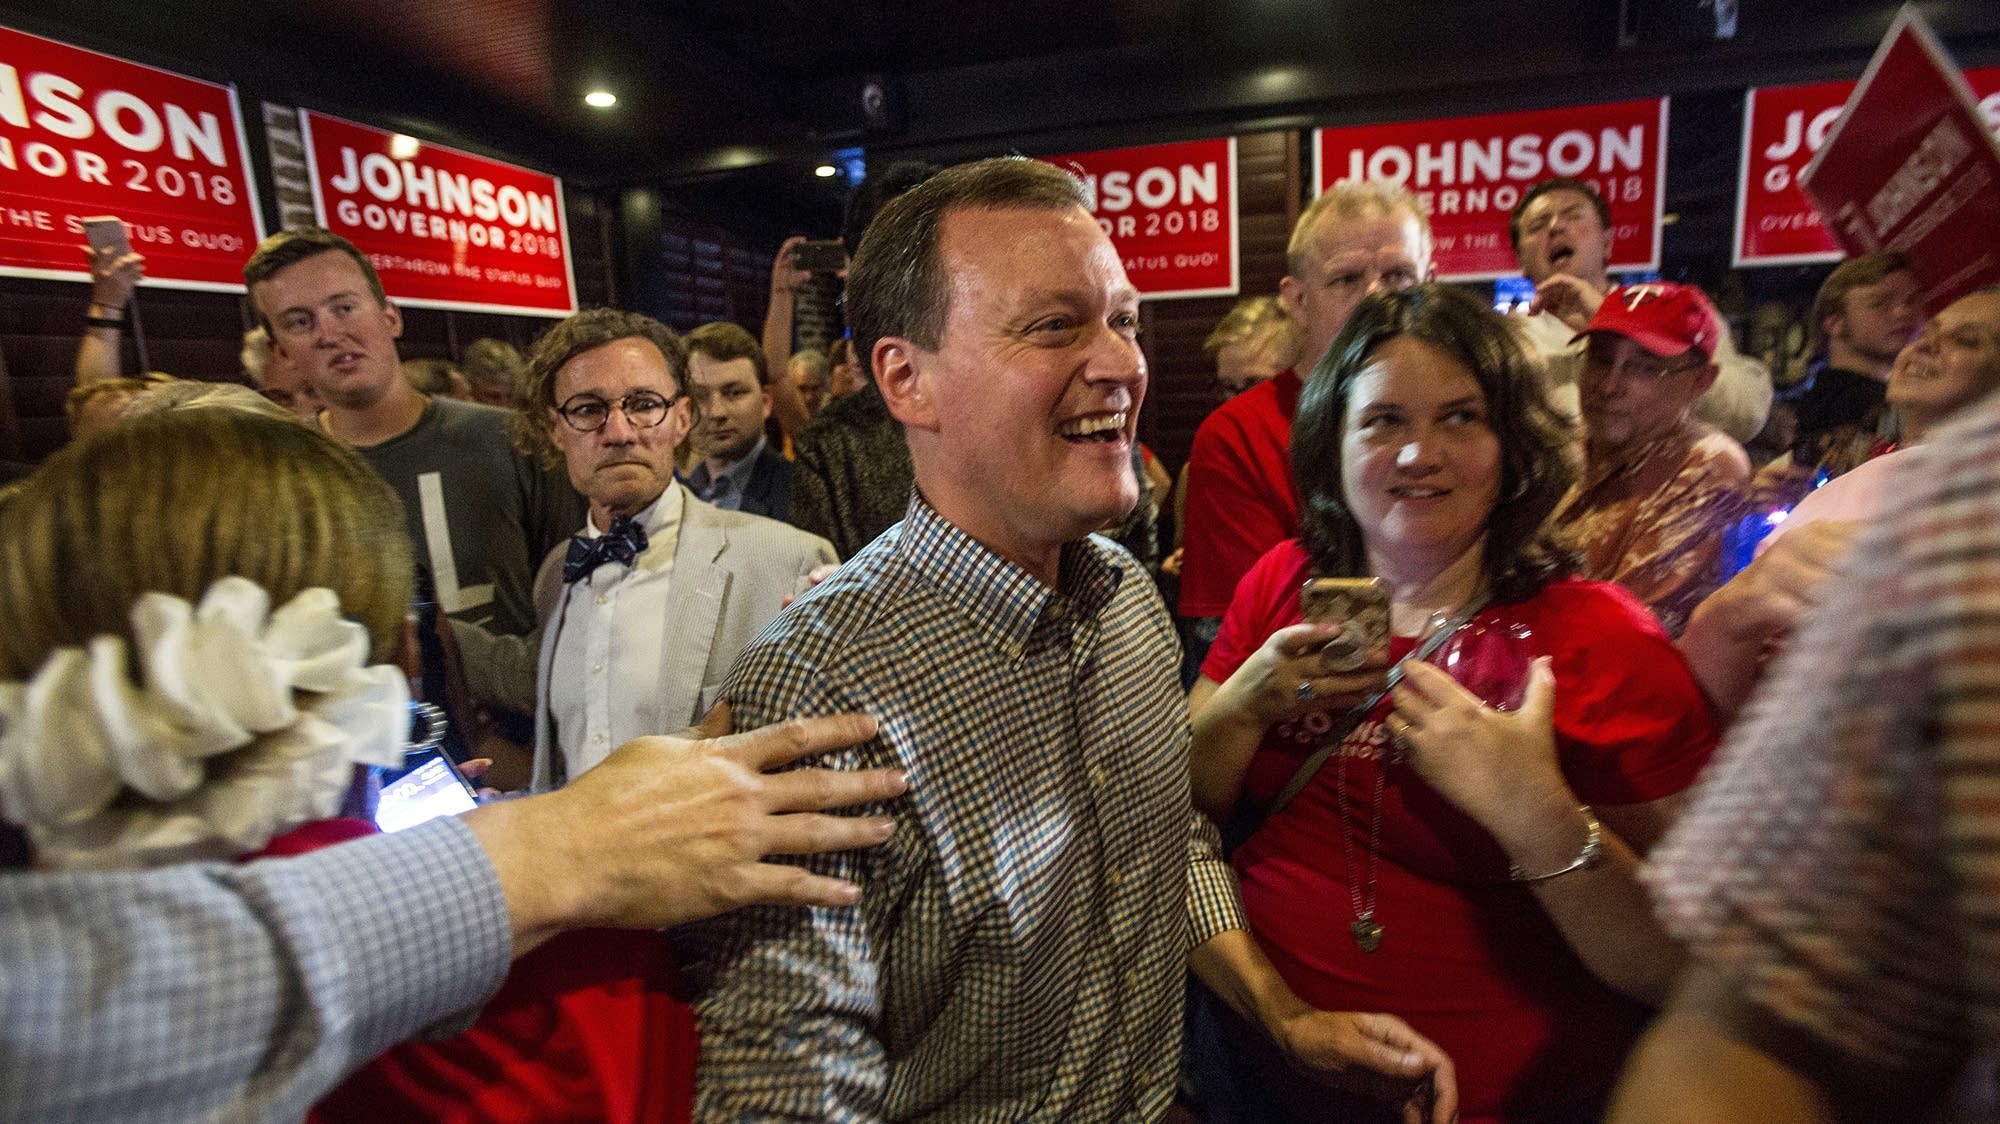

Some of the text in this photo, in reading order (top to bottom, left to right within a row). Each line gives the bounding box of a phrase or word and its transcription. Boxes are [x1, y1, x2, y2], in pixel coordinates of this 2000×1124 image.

[122, 159, 237, 206] 2018
[1336, 124, 1644, 190] JOHNSON
[331, 146, 557, 233] JOHNSON
[64, 214, 173, 245] STUS
[337, 199, 561, 259] GOVERNOR 2018
[1145, 207, 1220, 236] 2018
